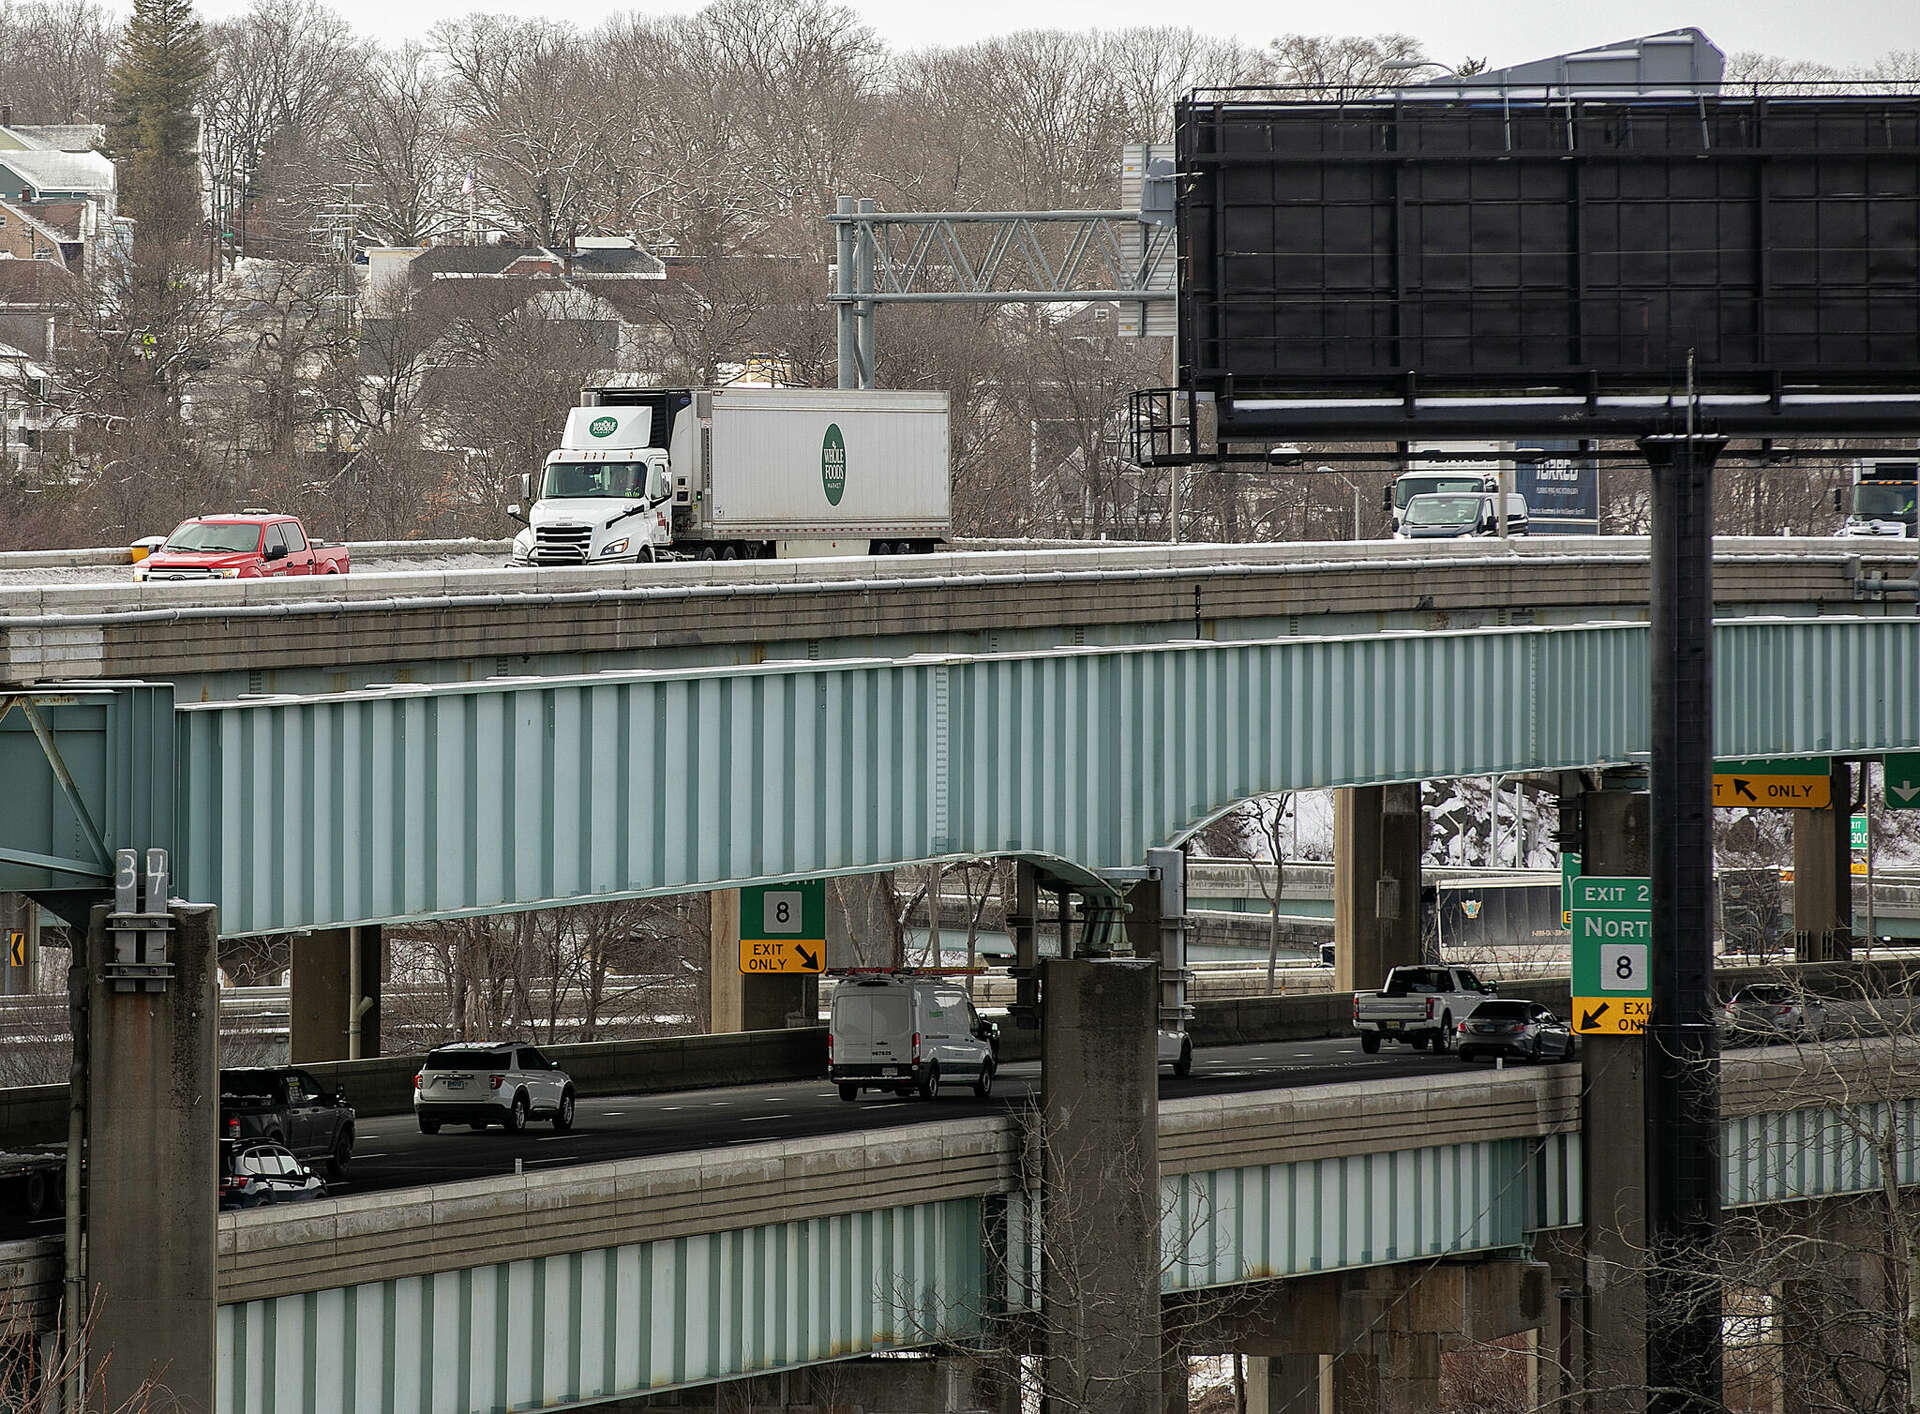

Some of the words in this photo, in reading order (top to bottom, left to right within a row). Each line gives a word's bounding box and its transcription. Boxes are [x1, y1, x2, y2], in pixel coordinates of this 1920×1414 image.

[824, 449, 844, 463] WHOLE
[825, 465, 844, 479] FOODS
[1768, 785, 1813, 798] ONLY
[1585, 887, 1626, 901] EXIT
[776, 902, 790, 923] 8
[1585, 917, 1652, 937] NORT
[753, 944, 784, 955] EXIT
[749, 959, 787, 970] ONLY
[1616, 955, 1633, 979] 8
[1623, 1002, 1650, 1014] EXI
